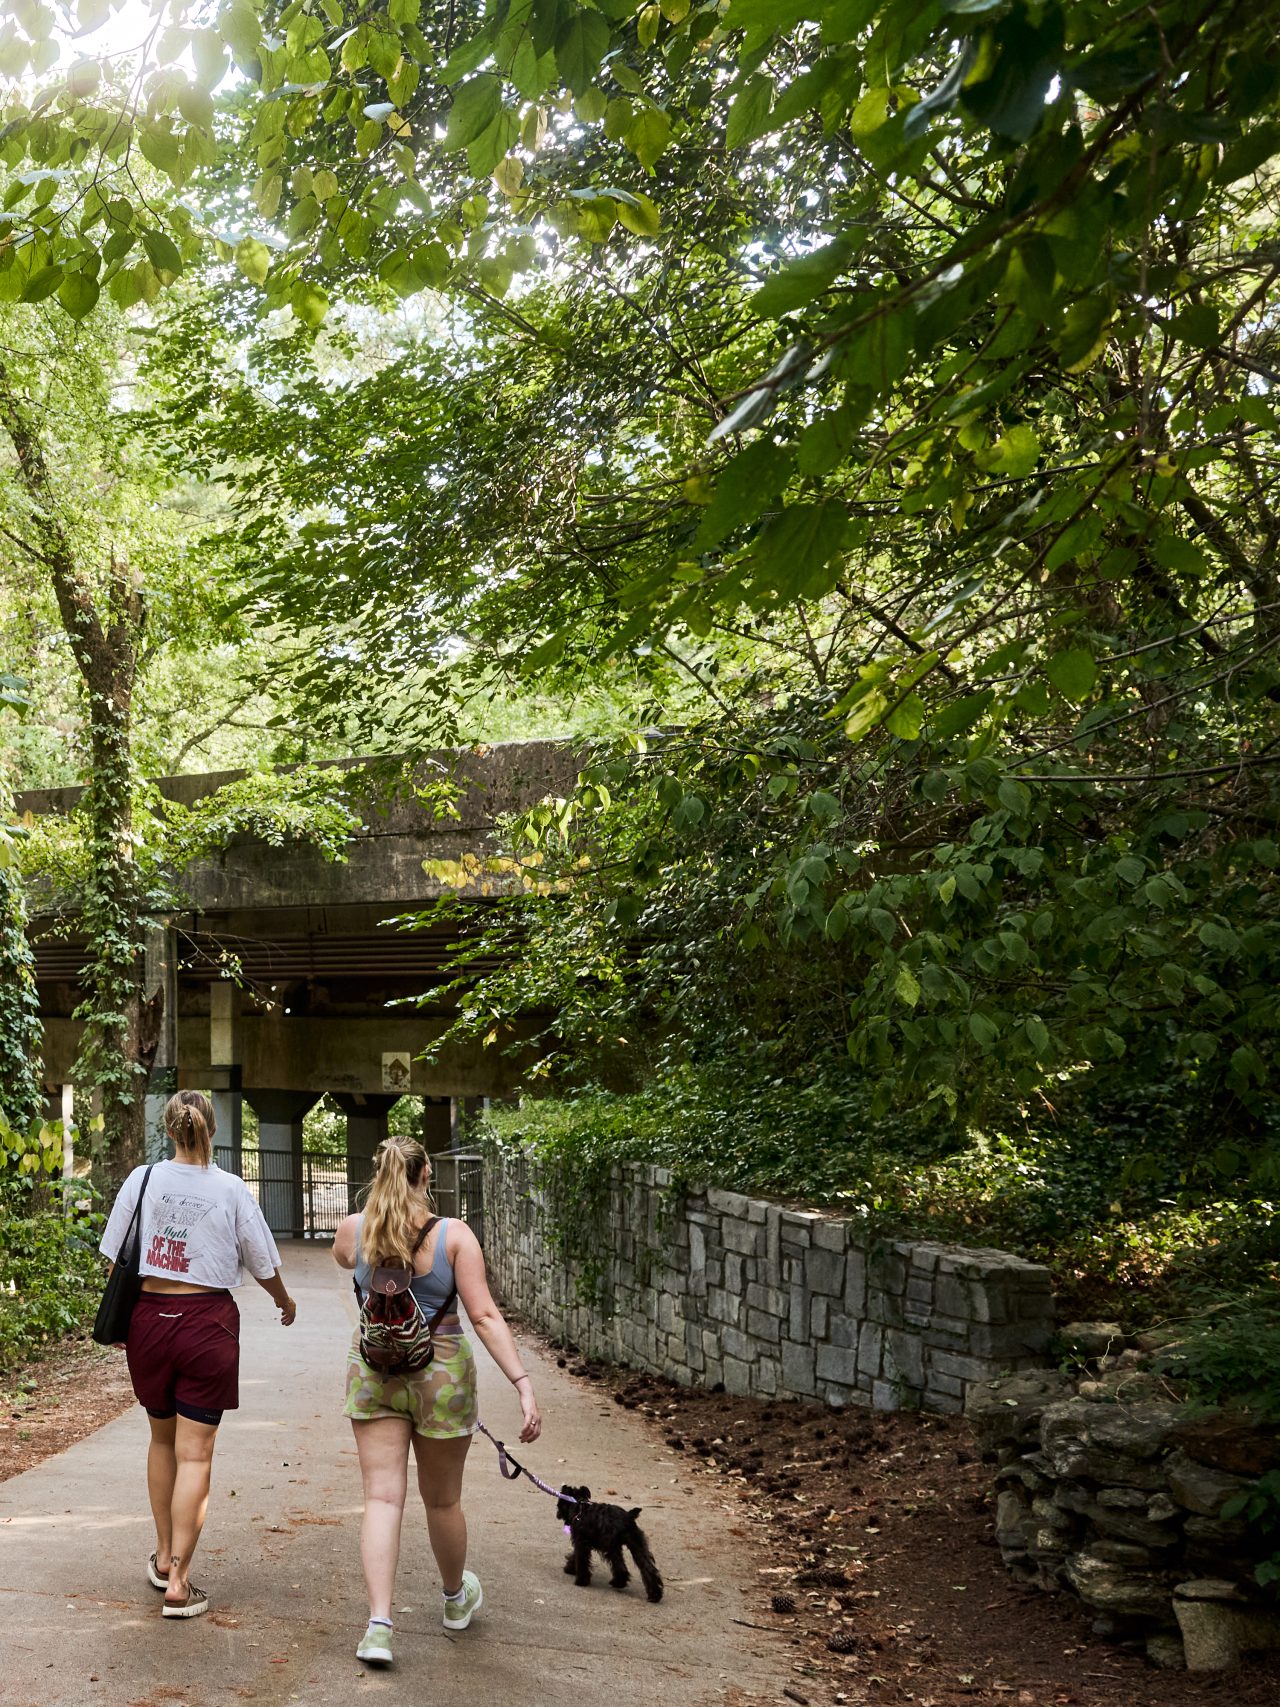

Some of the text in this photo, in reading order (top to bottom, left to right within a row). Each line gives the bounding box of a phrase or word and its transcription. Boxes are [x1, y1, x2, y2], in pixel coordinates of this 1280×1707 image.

[159, 1225, 188, 1240] Myth
[152, 1234, 187, 1257] OF THE
[146, 1248, 190, 1273] MACHINE
